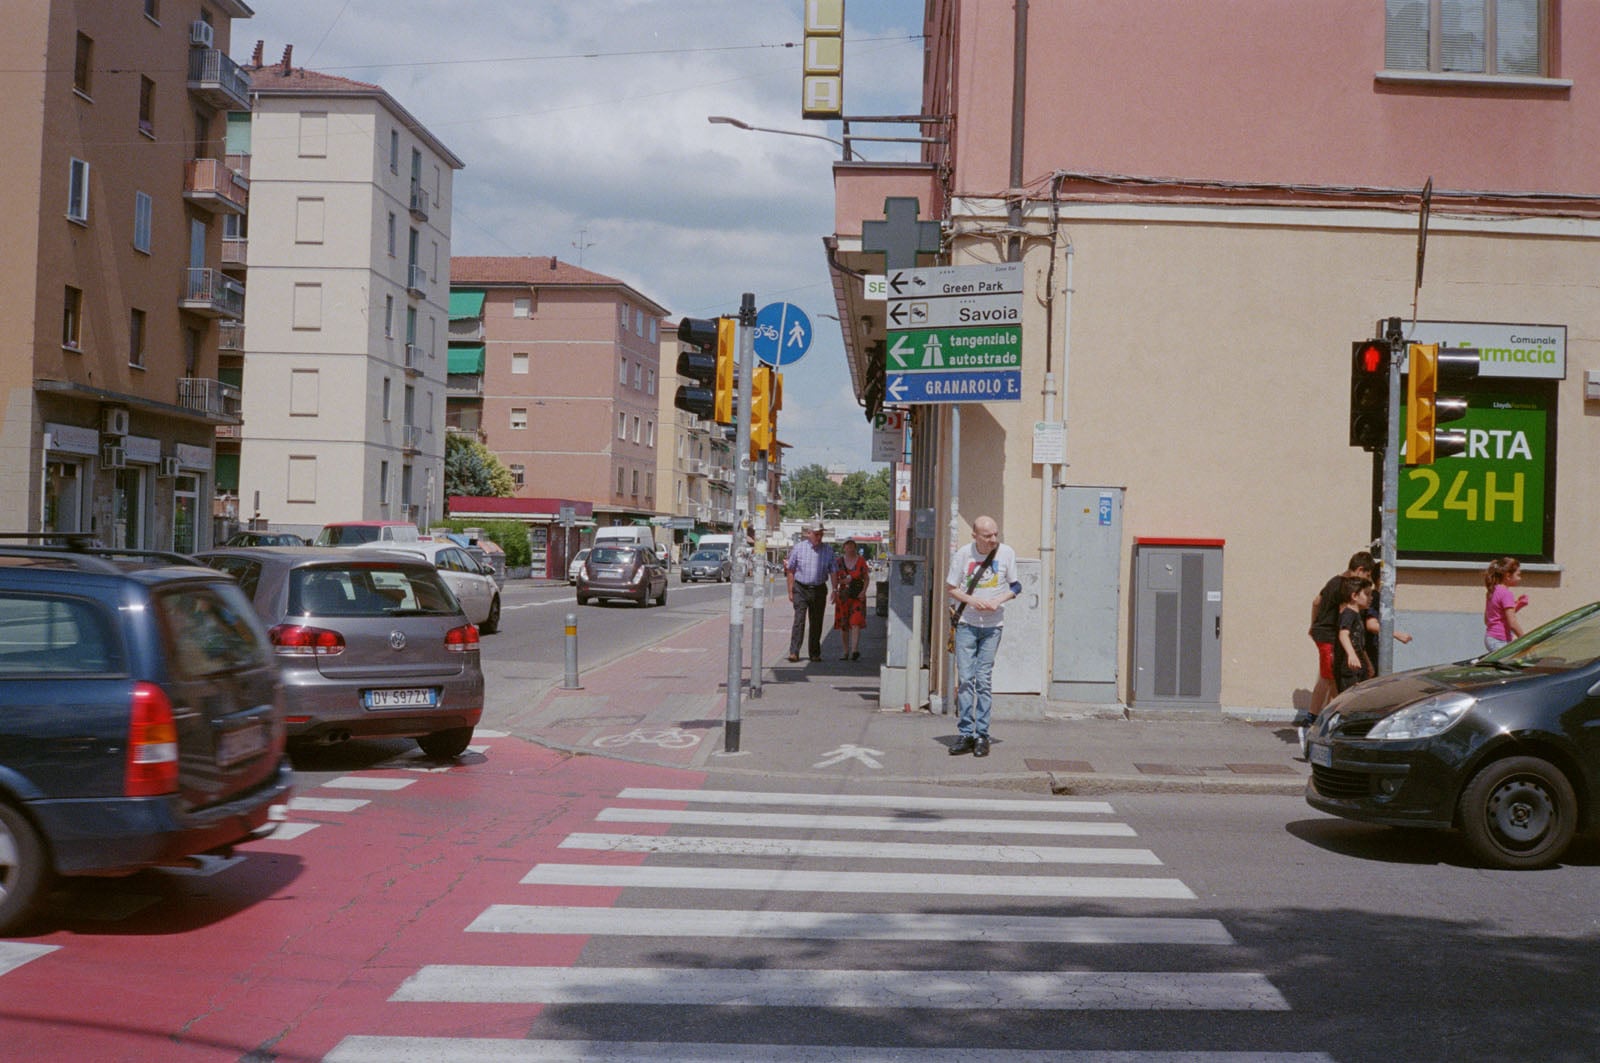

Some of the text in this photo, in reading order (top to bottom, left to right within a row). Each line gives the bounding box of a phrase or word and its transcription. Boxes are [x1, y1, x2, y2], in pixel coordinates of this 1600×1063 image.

[942, 281, 1004, 294] Green Park
[959, 306, 1018, 322] Savoia
[950, 332, 1018, 349] tangenziale
[1510, 334, 1557, 345] Comunale
[949, 352, 1017, 366] autostrade
[925, 378, 1019, 395] GRANAROLO E.
[1400, 428, 1533, 460] RTA
[1405, 468, 1525, 523] 24H
[373, 691, 388, 705] DV
